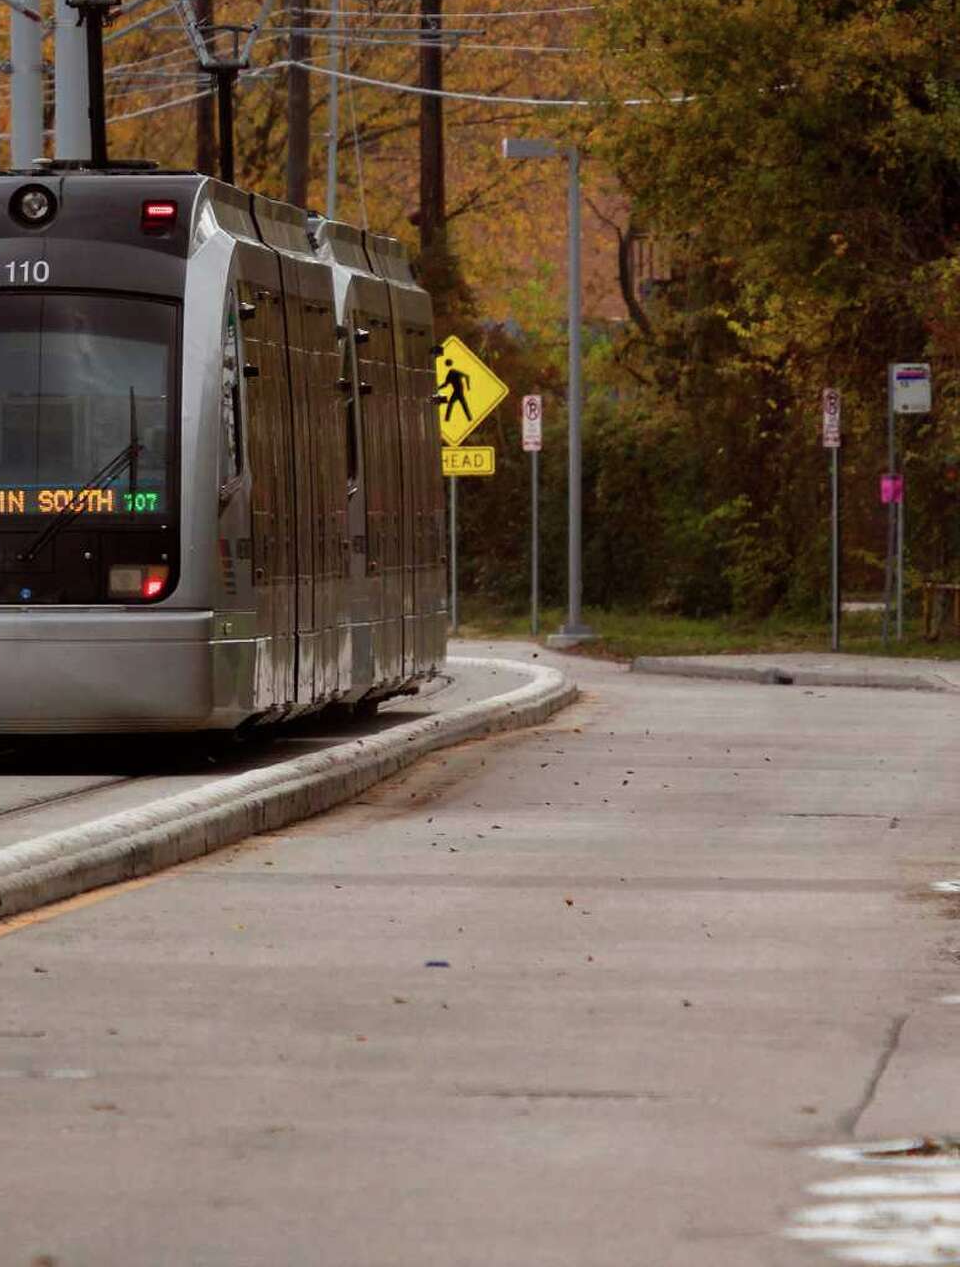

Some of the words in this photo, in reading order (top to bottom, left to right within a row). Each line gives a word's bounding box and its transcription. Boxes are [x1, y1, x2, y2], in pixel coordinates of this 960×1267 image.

[5, 261, 50, 283] 110
[442, 453, 484, 468] HEAD
[38, 489, 113, 513] SOUTH
